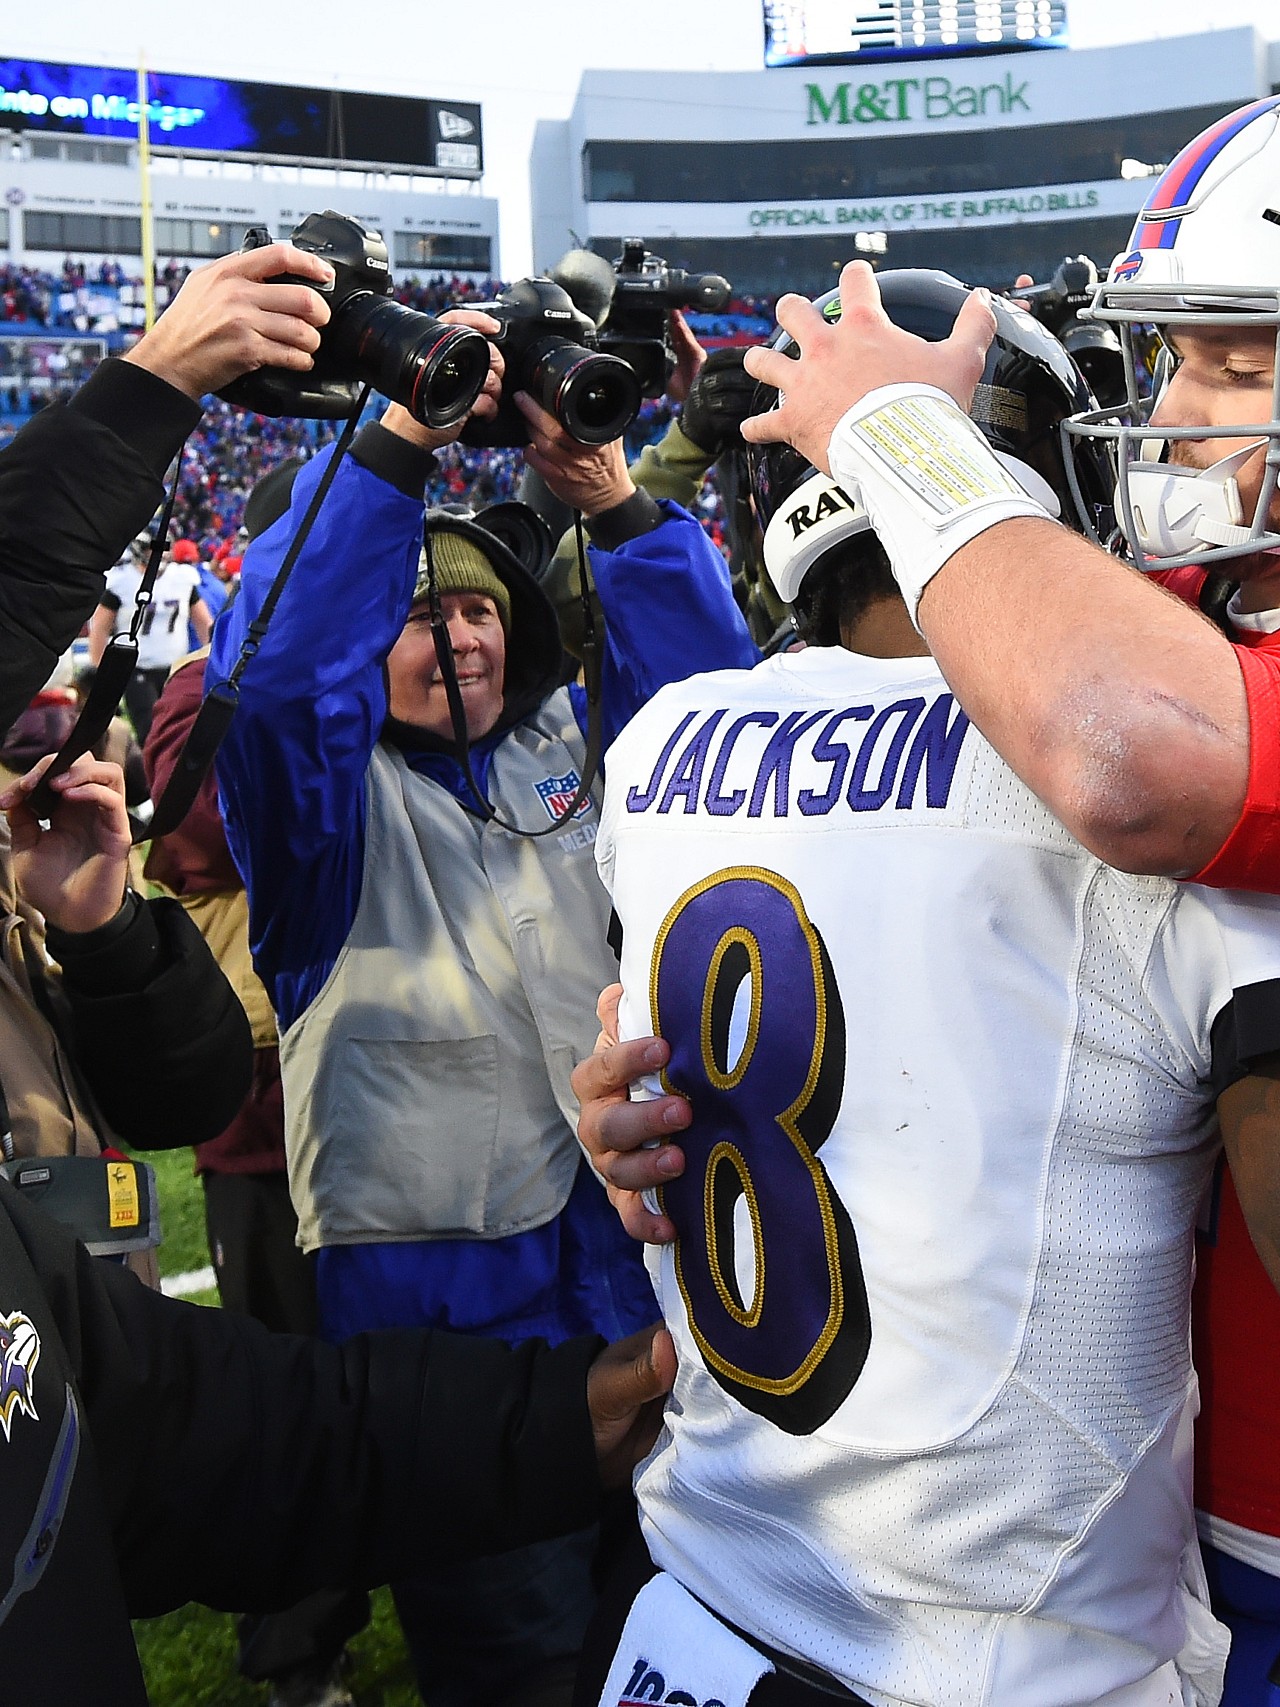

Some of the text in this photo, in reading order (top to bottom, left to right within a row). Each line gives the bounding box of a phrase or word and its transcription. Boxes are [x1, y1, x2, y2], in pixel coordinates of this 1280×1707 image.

[804, 70, 1031, 126] M&T Bank
[750, 189, 1099, 227] OFFICIAL BANK OF THE BUFFALO BILLS
[625, 692, 972, 818] JACKSON
[556, 822, 599, 853] MED
[648, 865, 873, 1436] 8
